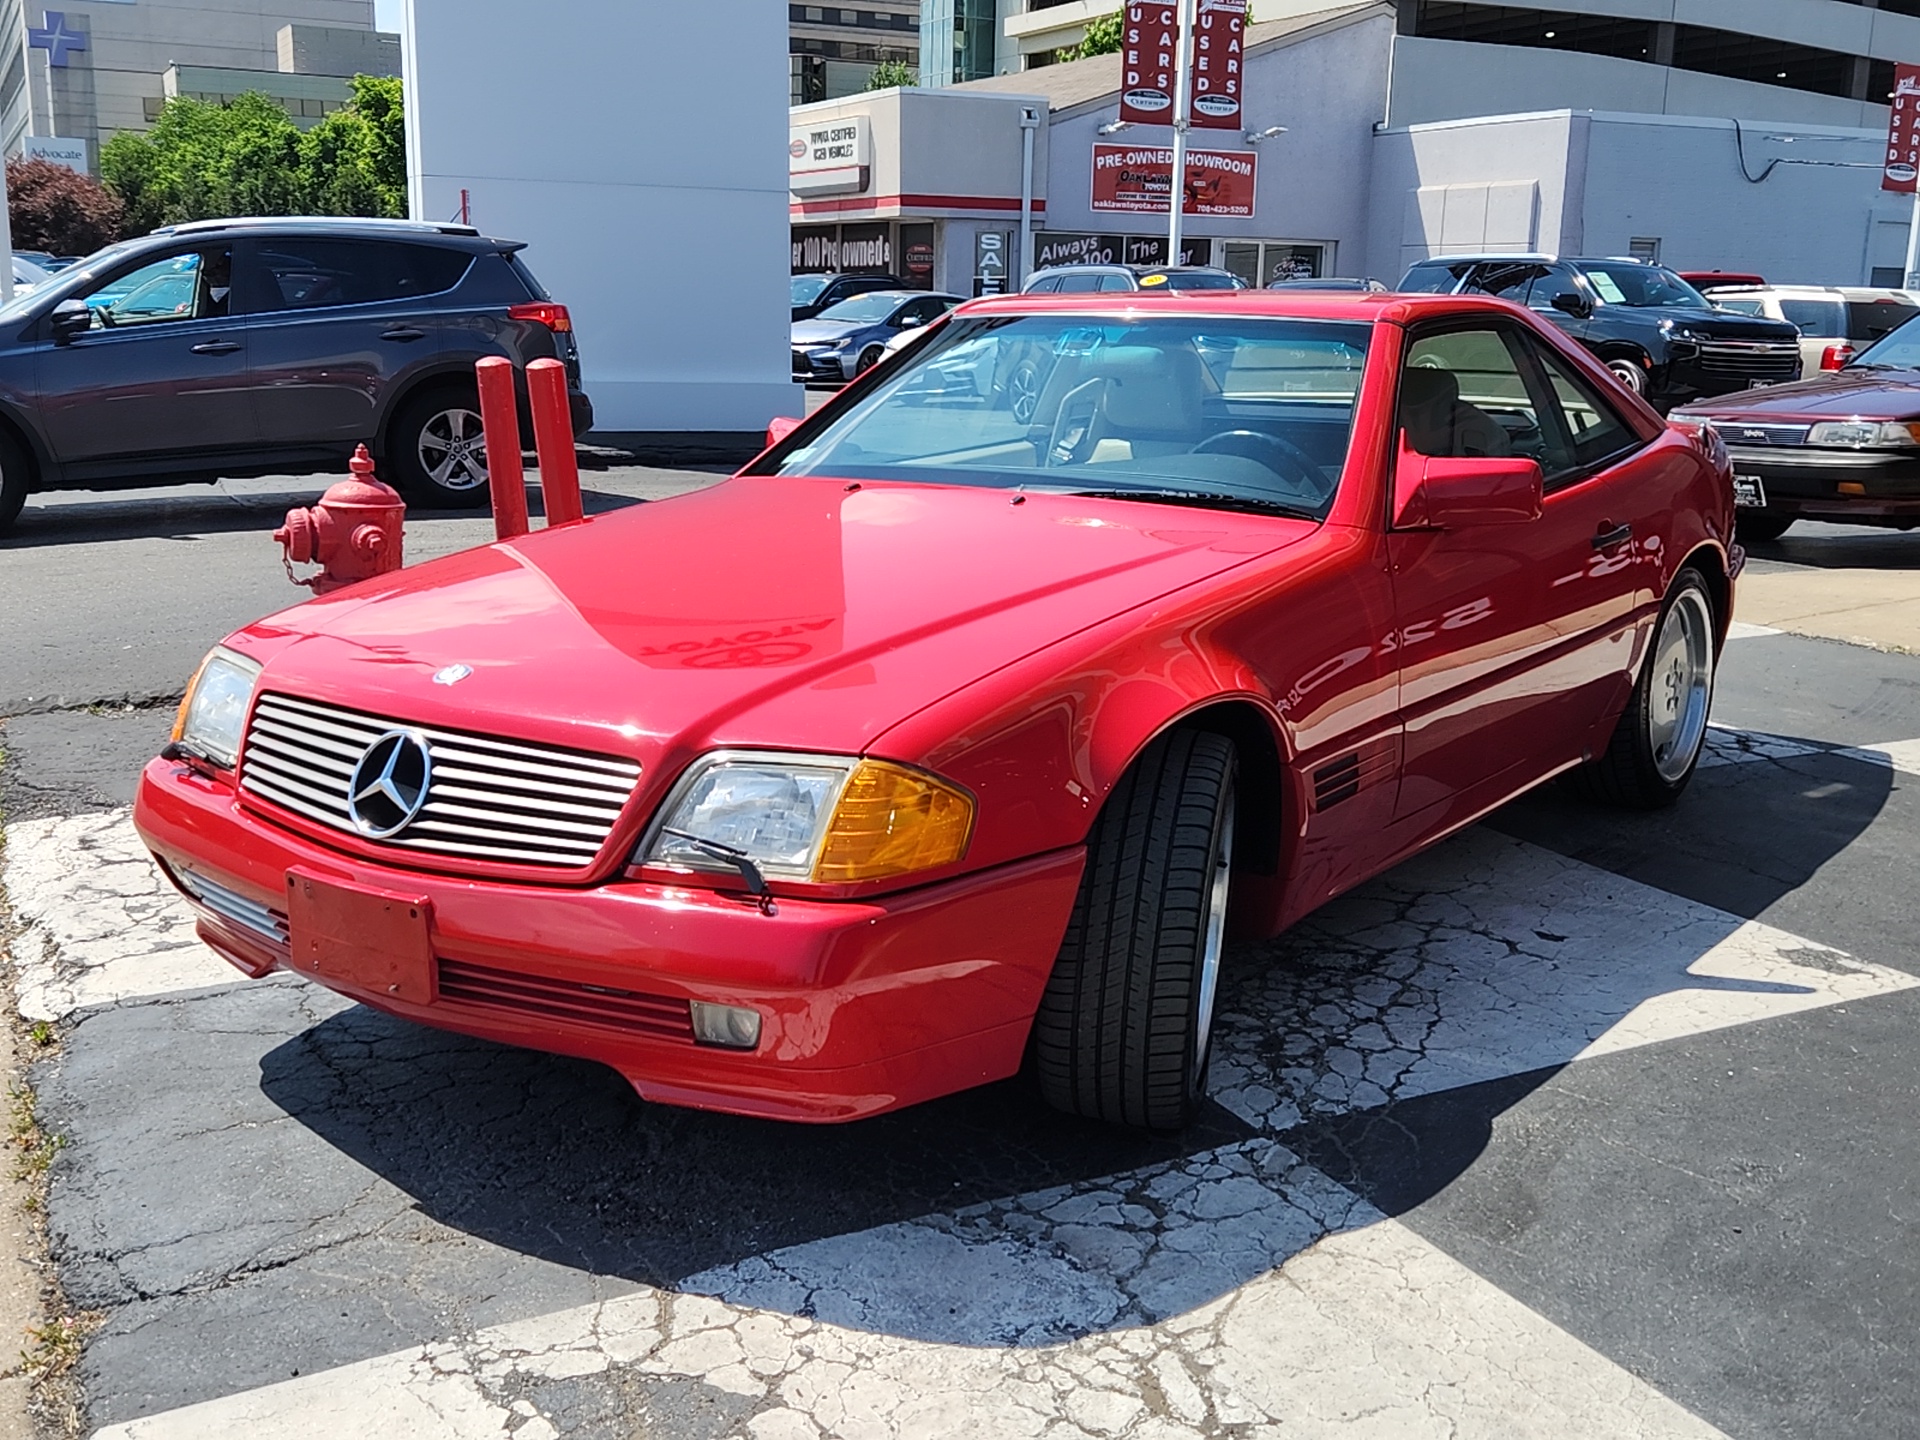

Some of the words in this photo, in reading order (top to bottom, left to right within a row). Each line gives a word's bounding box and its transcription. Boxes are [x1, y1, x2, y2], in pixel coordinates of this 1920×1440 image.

[1126, 8, 1142, 86] USED
[1157, 11, 1172, 88] CARS
[1197, 15, 1213, 91] USED
[1226, 18, 1241, 94] CARS
[1888, 98, 1904, 160] USED
[31, 147, 82, 160] Advocate
[1096, 151, 1173, 170] PRE-OWNED
[1185, 152, 1252, 176] HOWROOM
[792, 242, 802, 267] er
[804, 237, 820, 267] 100
[821, 237, 838, 267] Pre
[842, 235, 883, 267] owned
[1038, 237, 1098, 264] Always
[1083, 248, 1113, 265] 100
[1130, 240, 1159, 261] The
[1179, 249, 1194, 266] ar
